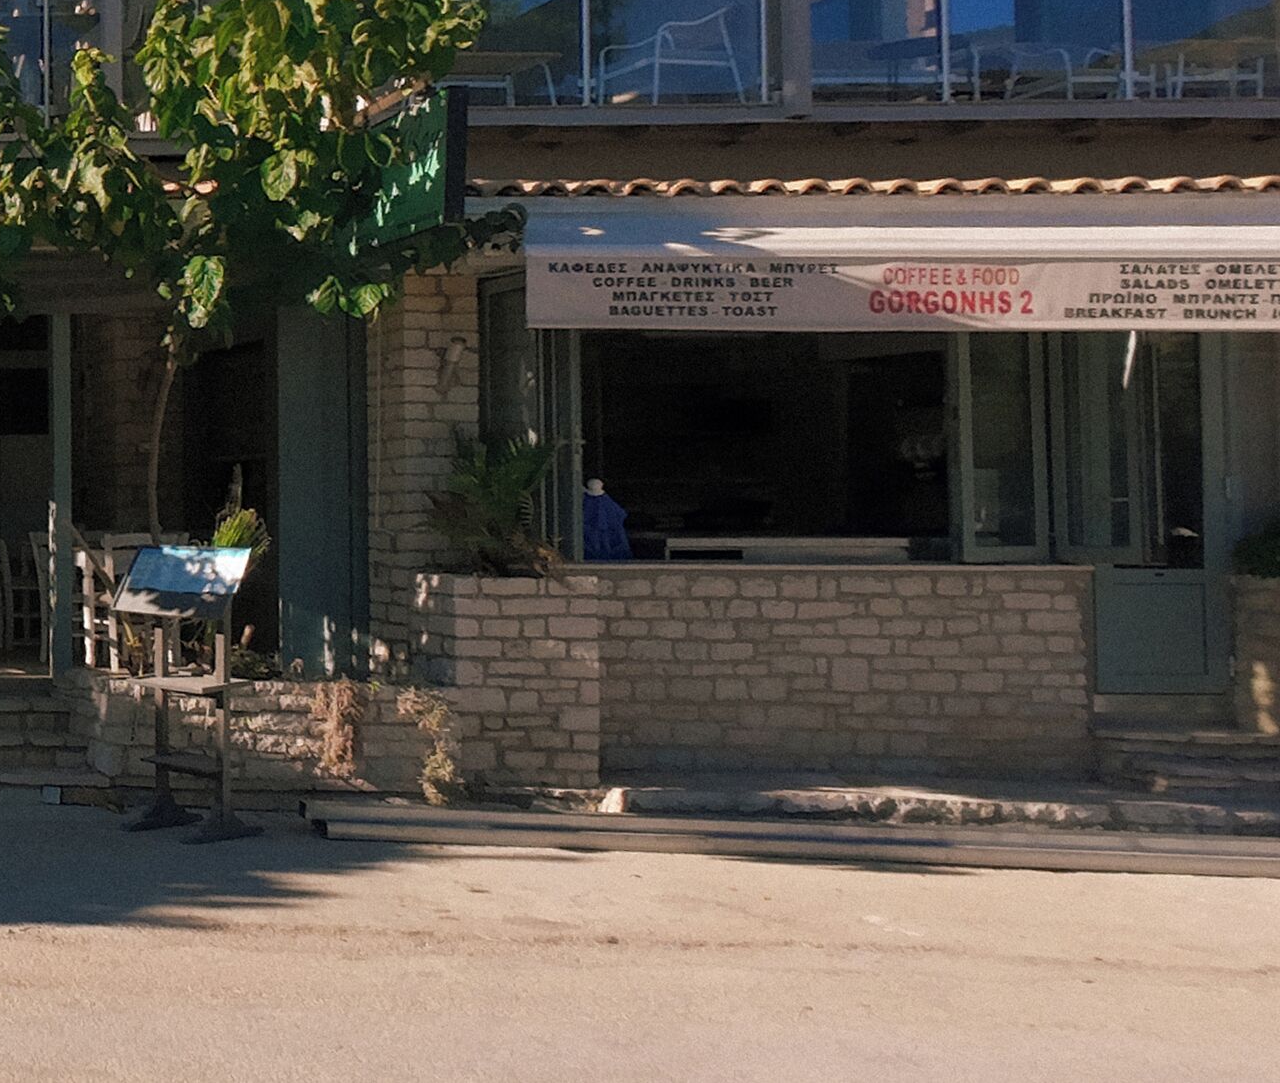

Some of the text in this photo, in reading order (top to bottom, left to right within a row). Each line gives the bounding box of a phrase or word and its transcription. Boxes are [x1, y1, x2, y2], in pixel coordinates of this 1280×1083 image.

[641, 263, 756, 273] ΑΝΑΨΥΚΤΙΚΑ
[769, 263, 839, 274] ΜΠΥΡΕΣ
[1120, 264, 1280, 275] ΣΑΛΑΤΕΣ ΟΜΕΛΕ
[883, 268, 1020, 285] COFFEE & FOOD
[592, 277, 794, 288] COFFEE DRINKS BEER
[1121, 279, 1280, 289] SALADS OMELET
[612, 291, 774, 302] ΜΠΑΓΚΕΤΕΣ ΤΟΣΤ
[869, 290, 1033, 314] GORGONHS 2
[1173, 294, 1259, 304] ΜΠΡΑΝΤΣ
[609, 306, 778, 316] BAGUETTES TOAST
[1064, 308, 1257, 319] BREAKFAST BRUNCH
